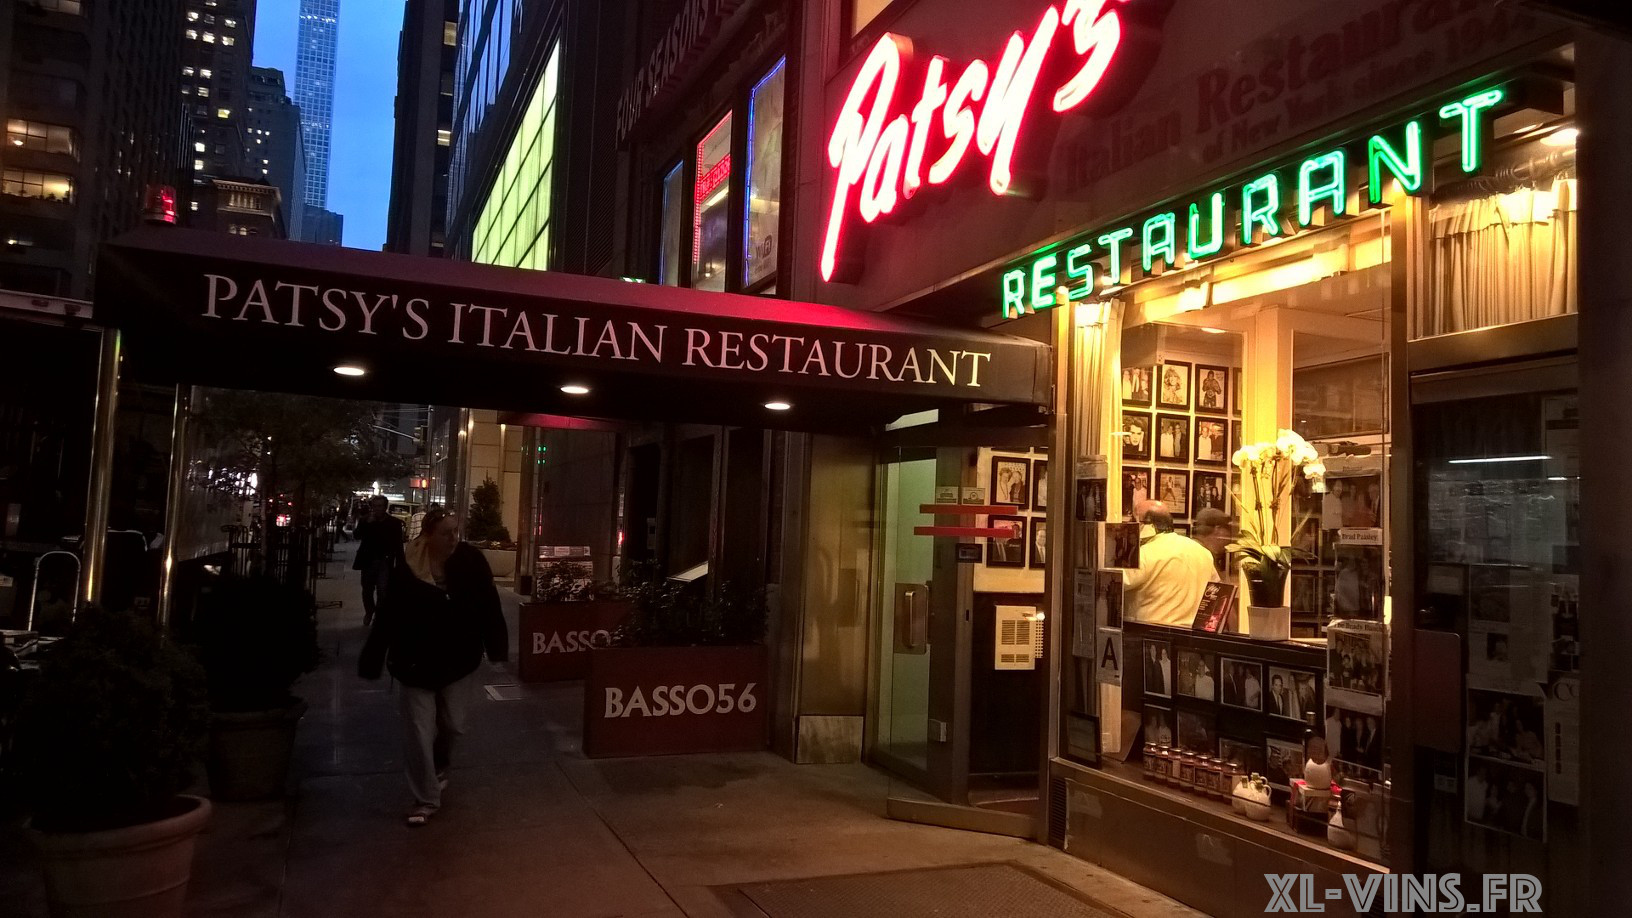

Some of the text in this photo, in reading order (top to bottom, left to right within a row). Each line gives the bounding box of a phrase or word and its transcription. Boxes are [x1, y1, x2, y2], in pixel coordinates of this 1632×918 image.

[1001, 88, 1506, 319] RESTAURANT
[201, 273, 992, 388] PATSY'S ITALIAN RESTAURANT
[532, 630, 611, 654] BASSO
[1101, 637, 1118, 671] A
[604, 682, 757, 718] BASSO56
